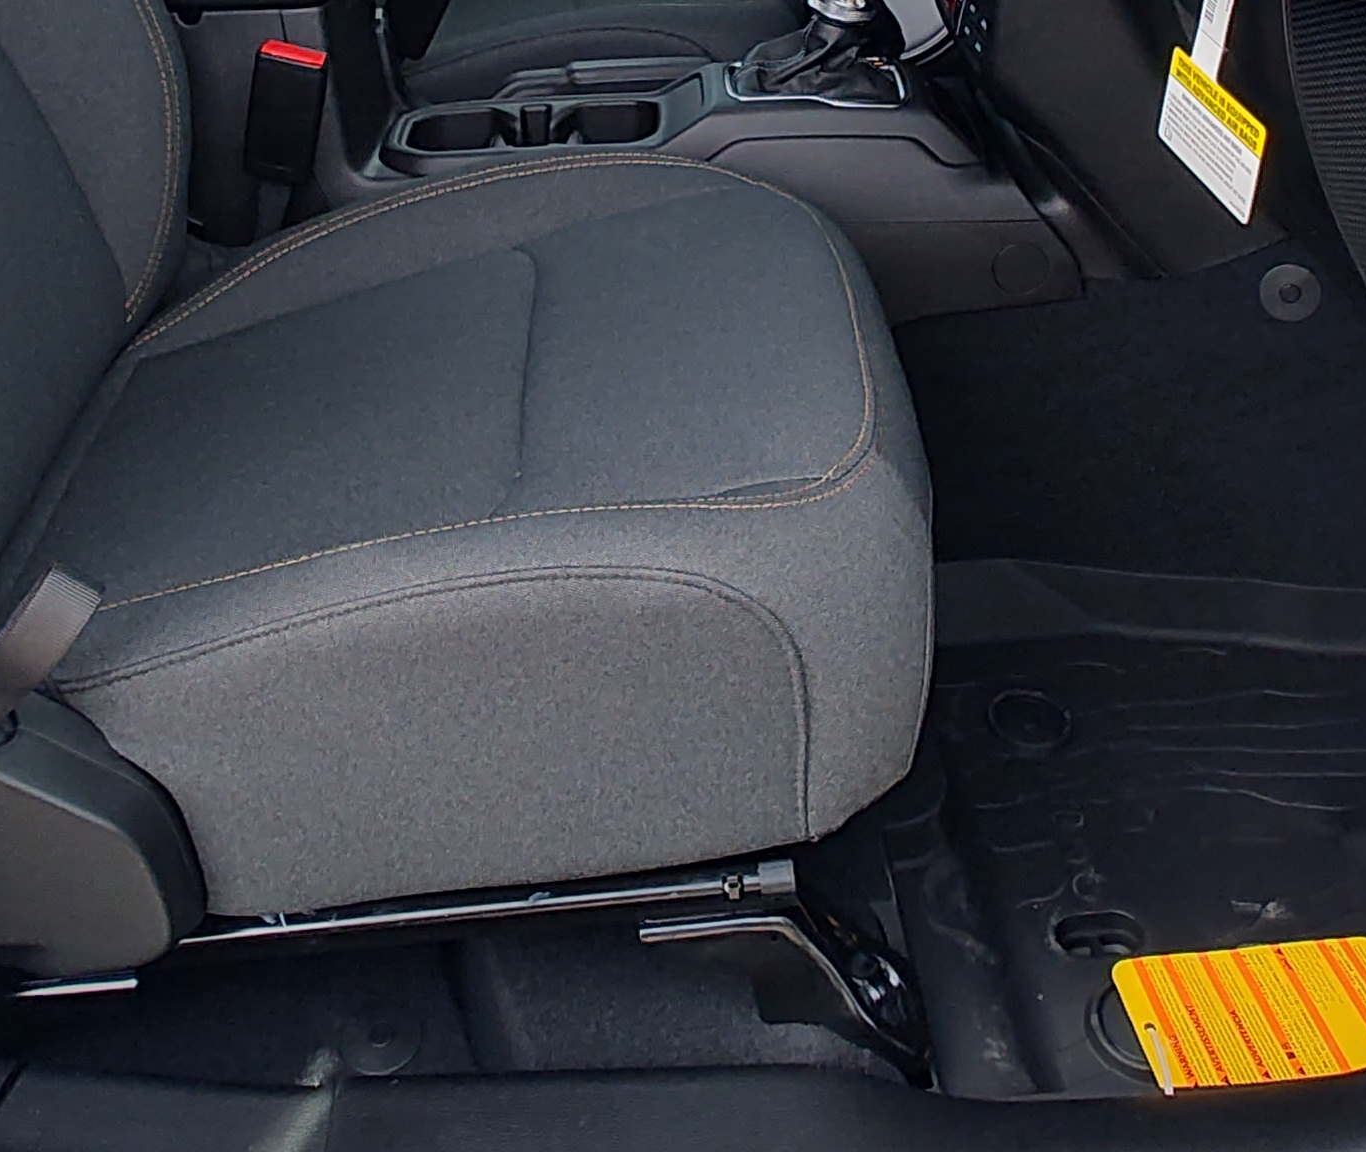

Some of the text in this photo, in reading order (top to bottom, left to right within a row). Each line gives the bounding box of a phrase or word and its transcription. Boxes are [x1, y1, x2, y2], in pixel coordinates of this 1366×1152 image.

[1191, 68, 1219, 101] VEHICLE
[1225, 101, 1260, 140] EQUIPPED
[1191, 82, 1226, 121] ADVANCED
[1225, 114, 1238, 133] AIR
[1238, 126, 1257, 151] BAGS
[1167, 1034, 1195, 1079] WARNING
[1183, 1003, 1224, 1072] AVERTISSEMENT
[1227, 1008, 1265, 1068] ADVERTENCIA
